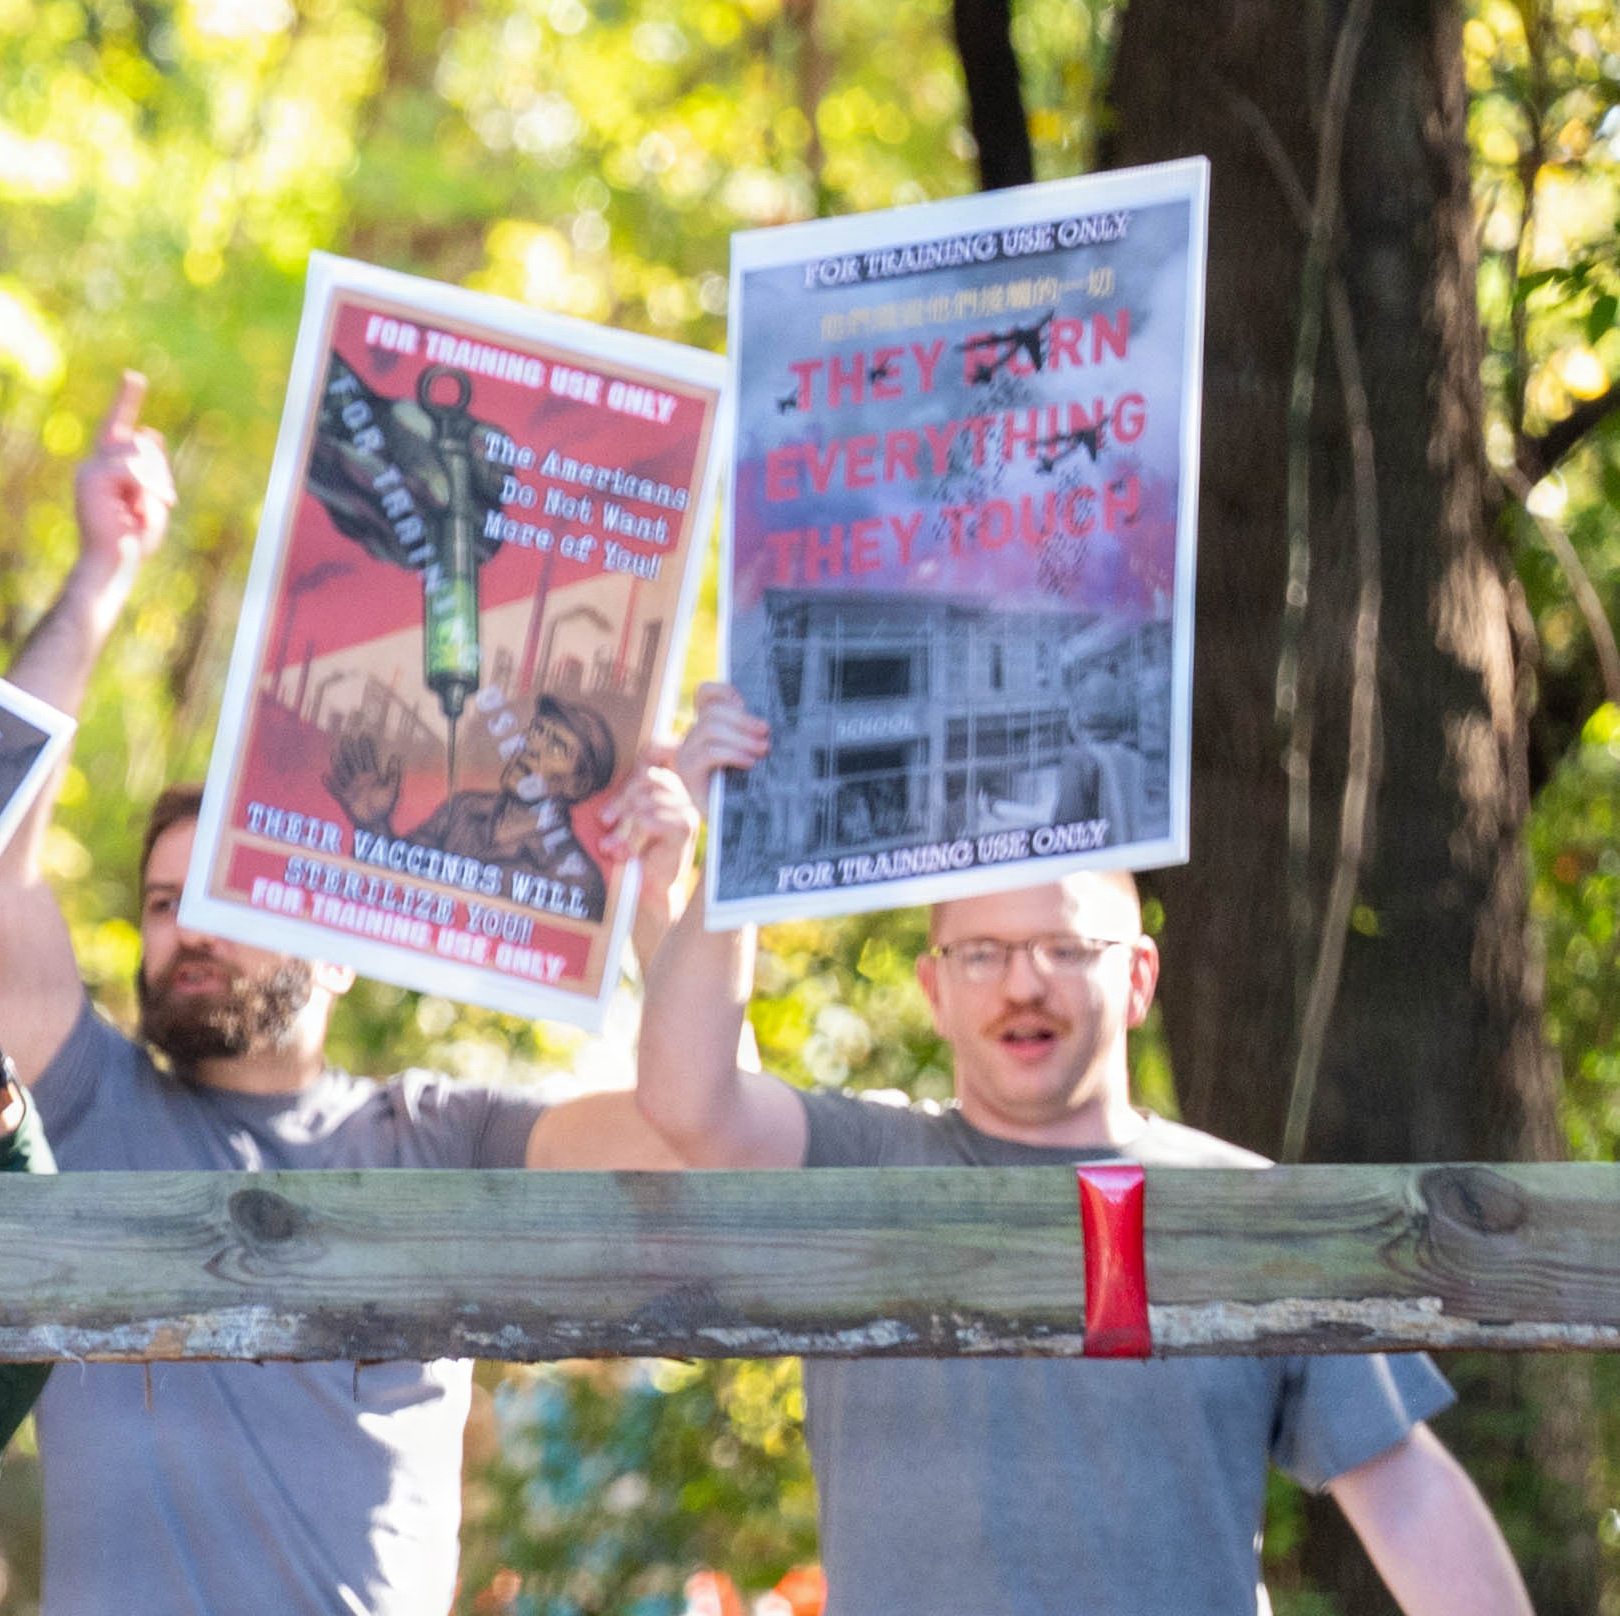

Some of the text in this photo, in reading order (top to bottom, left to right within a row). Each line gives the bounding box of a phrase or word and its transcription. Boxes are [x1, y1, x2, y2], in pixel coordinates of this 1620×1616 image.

[804, 210, 1132, 288] FOR TRAINING USE ONLY
[365, 315, 678, 425] FOR TRAINING USE ONLY
[789, 340, 946, 412] THEY
[328, 374, 386, 455] FOR
[765, 392, 1147, 501] EVERYTHING
[484, 431, 691, 512] The Americans
[499, 473, 669, 545] Do Not Want
[484, 509, 661, 581] More of You!
[764, 475, 1141, 583] THEY TOUCH
[247, 801, 590, 919] THEIR VACCINES WILL
[776, 819, 1110, 891] FOR TRAINING USE ONLY
[251, 876, 566, 983] FOR TRAINING USE ONLY
[284, 855, 534, 945] STERILIZE YOU!
